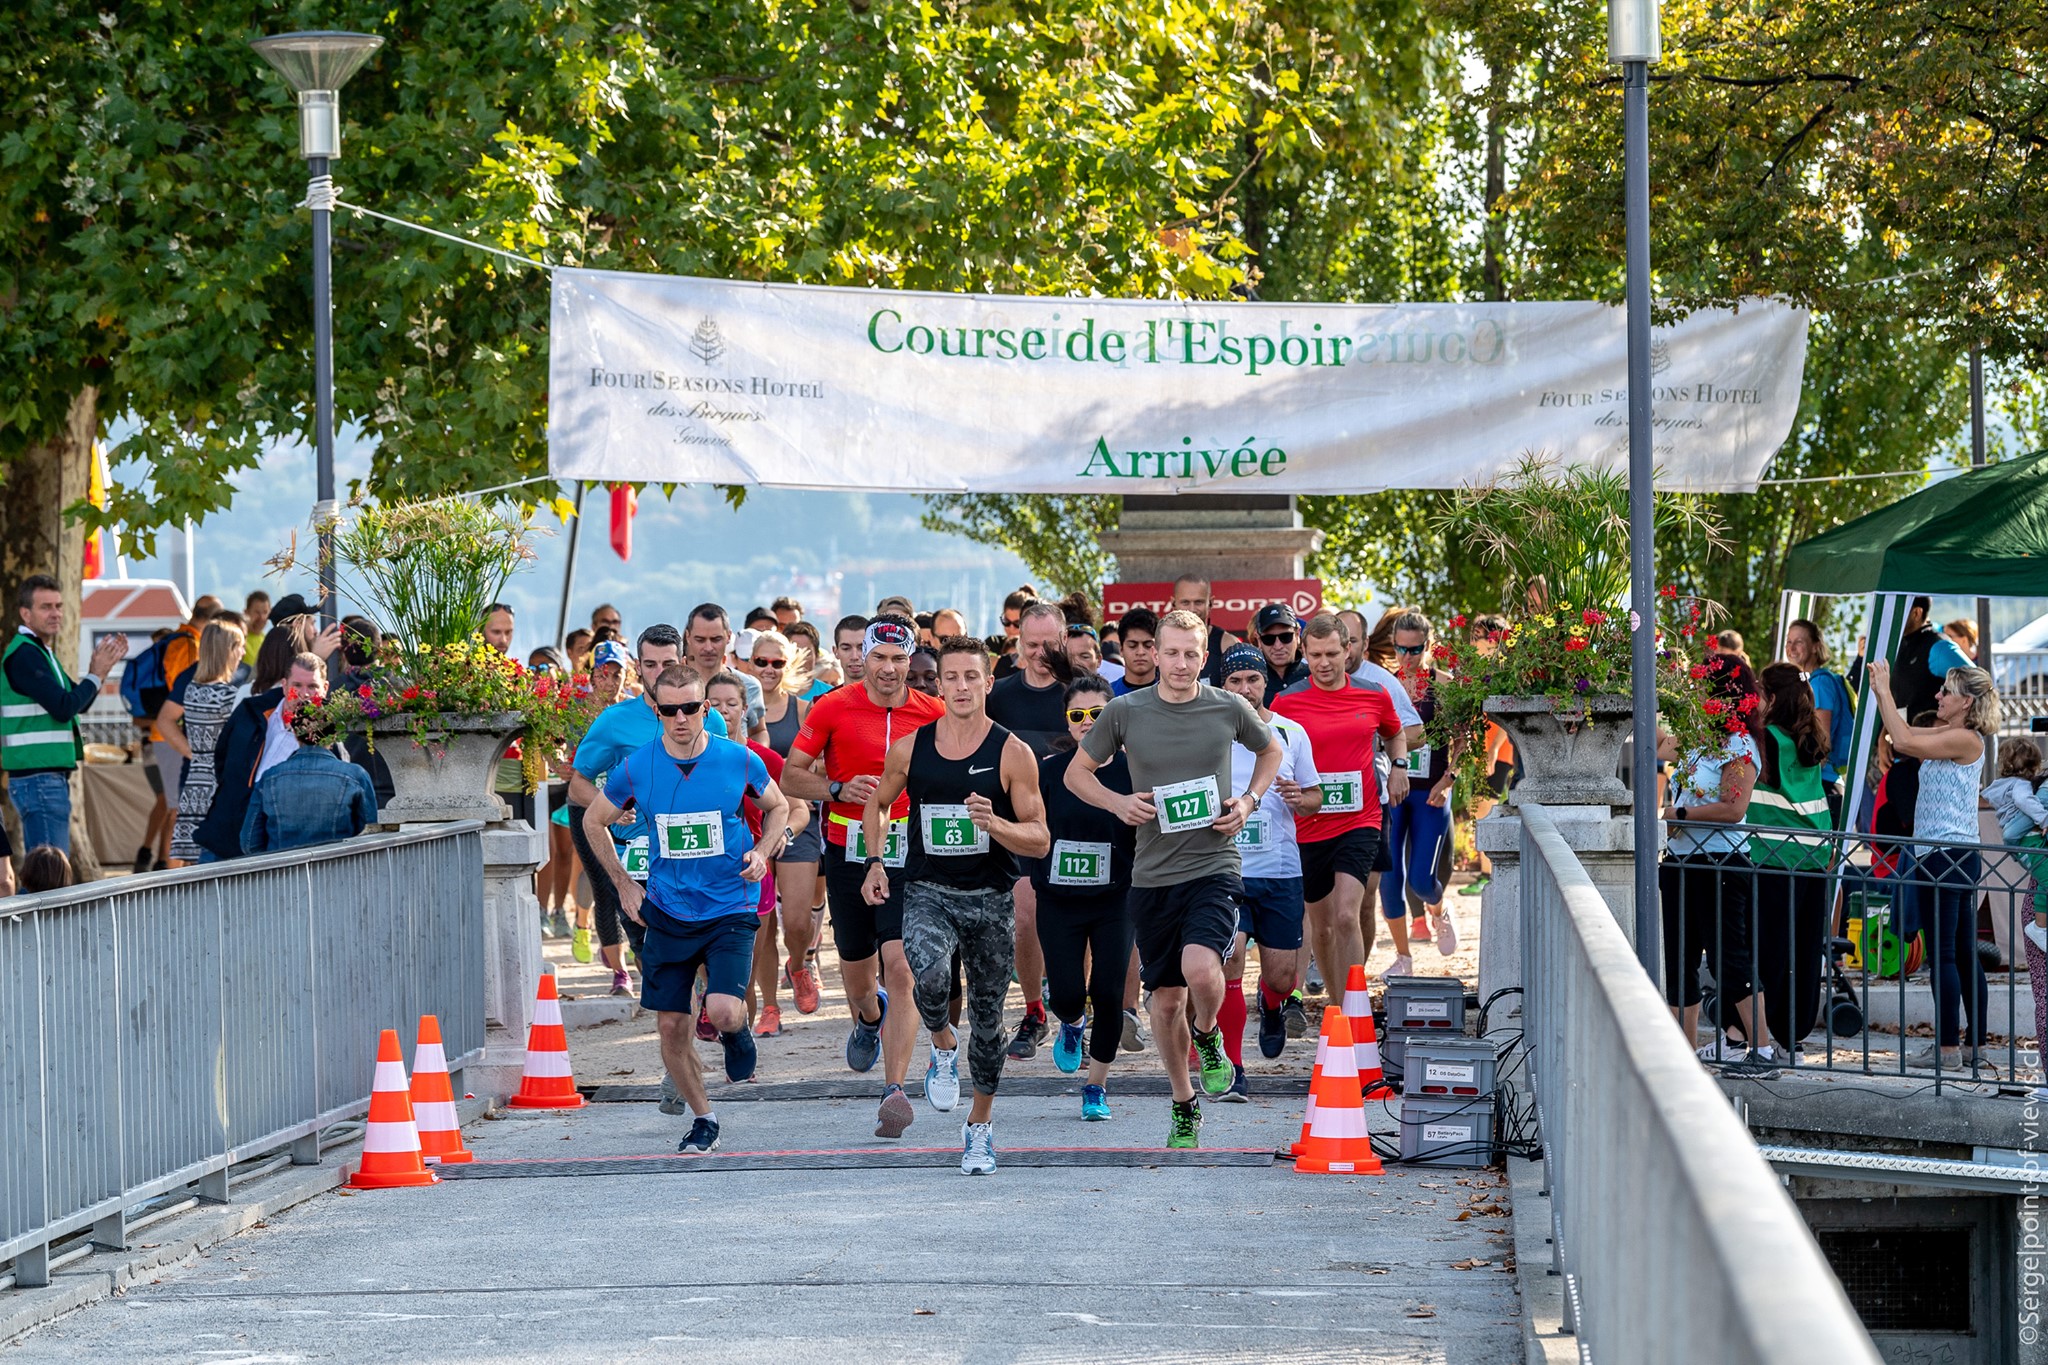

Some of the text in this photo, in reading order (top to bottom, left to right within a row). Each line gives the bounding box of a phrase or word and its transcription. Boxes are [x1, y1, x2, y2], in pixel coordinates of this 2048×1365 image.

[867, 309, 1352, 376] Course de l'Espoir
[589, 367, 824, 399] FOUR SEASONS HOTEL
[1538, 383, 1762, 407] FOUR SEONS HOTEL
[1625, 408, 1704, 433] ergues
[1075, 435, 1288, 479] Arrivée
[1171, 797, 1200, 818] 127
[1328, 791, 1344, 804] 62
[681, 826, 693, 835] IAN
[945, 829, 963, 845] 63
[681, 834, 699, 849] 75
[1064, 857, 1090, 874] 112
